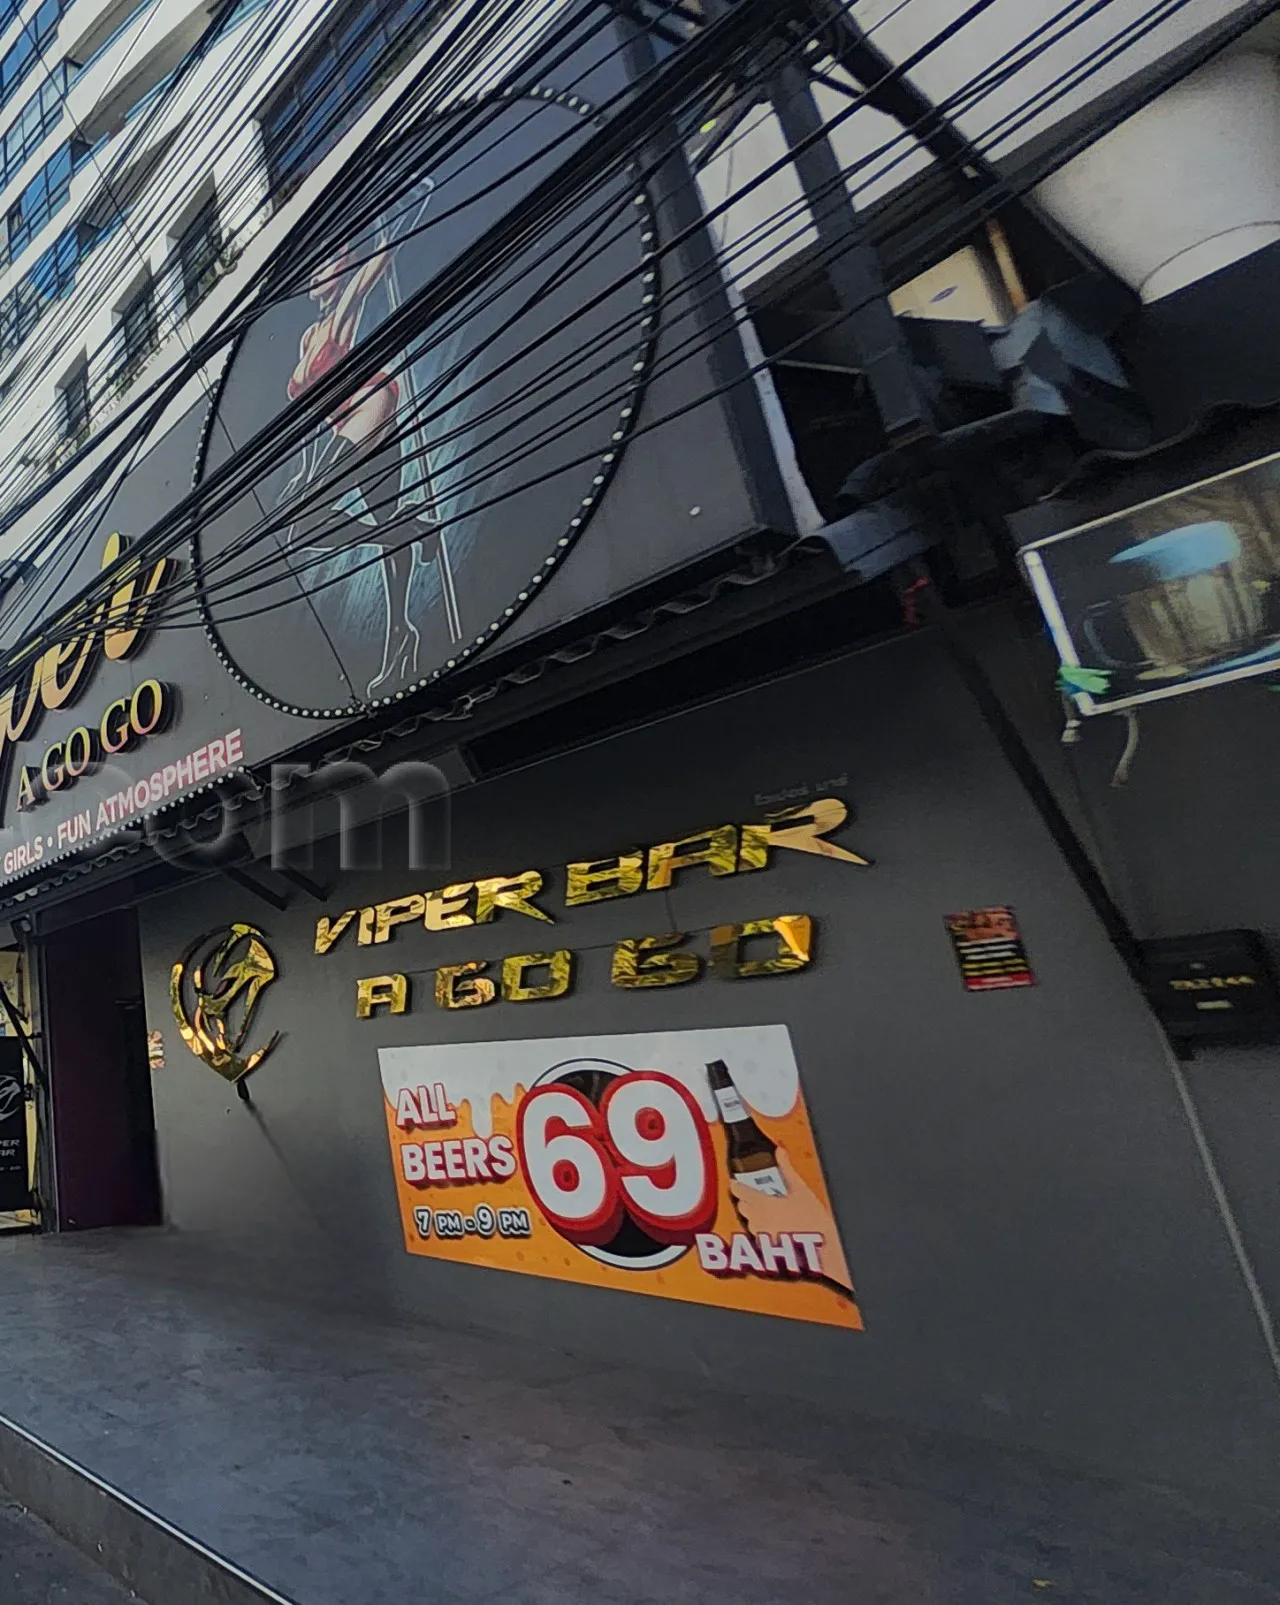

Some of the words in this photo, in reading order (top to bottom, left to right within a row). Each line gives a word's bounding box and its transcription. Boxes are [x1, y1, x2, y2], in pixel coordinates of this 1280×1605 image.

[16, 765, 36, 812] A
[41, 726, 91, 791] GO
[100, 679, 163, 753] GO
[3, 836, 44, 875] GIRLS
[57, 809, 91, 850] FUN
[95, 728, 244, 831] ATMOSPHERE
[312, 868, 557, 955] VIPER
[565, 797, 869, 907] BAR
[355, 972, 410, 1019] A
[435, 949, 574, 1010] GO
[610, 914, 814, 989] GO
[396, 1082, 458, 1128] ALL
[518, 1072, 718, 1232] 69
[400, 1134, 517, 1185] BEERS
[415, 1206, 432, 1236] 7
[436, 1211, 462, 1236] PM
[475, 1203, 495, 1236] 9
[498, 1208, 532, 1236] PM
[696, 1231, 825, 1276] BAHT
